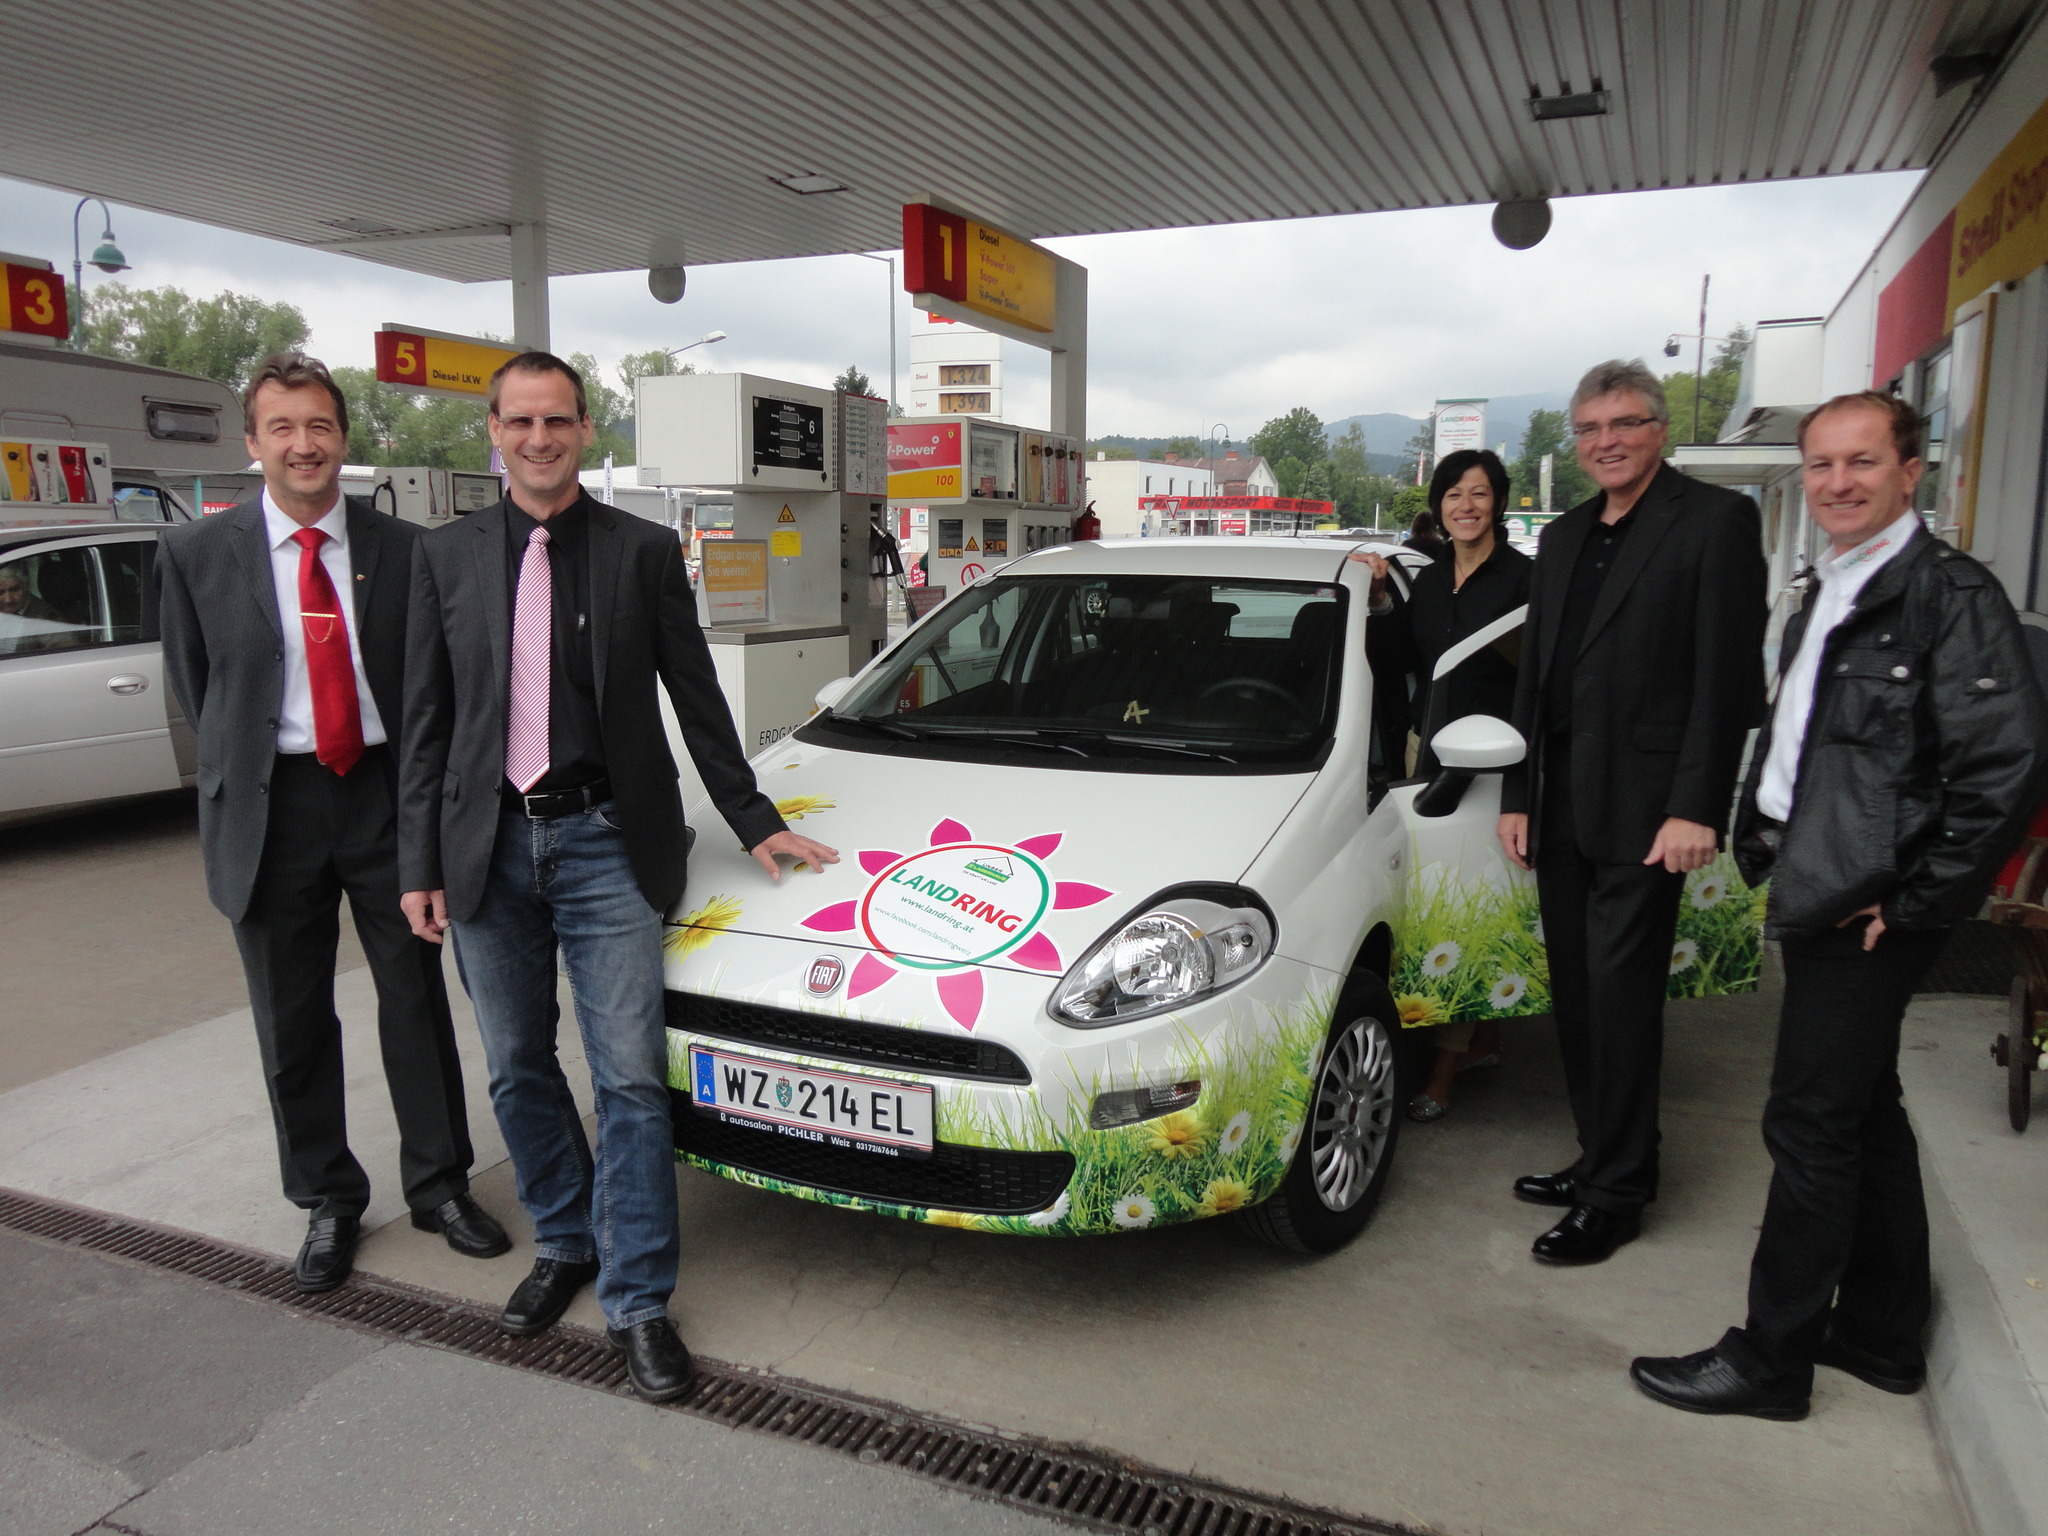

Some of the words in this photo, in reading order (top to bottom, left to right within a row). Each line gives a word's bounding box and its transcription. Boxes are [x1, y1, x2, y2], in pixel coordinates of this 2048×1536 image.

[979, 228, 1000, 247] Diesel
[1957, 187, 2006, 278] Shell
[939, 224, 953, 282] 1
[979, 269, 999, 286] Super
[24, 278, 55, 325] 3
[395, 341, 417, 376] 5
[432, 369, 459, 382] Diesel
[461, 375, 481, 385] LKW
[915, 373, 929, 381] Diesel
[915, 401, 928, 410] Super
[808, 420, 816, 435] 6
[936, 475, 954, 486] 100
[1186, 496, 1260, 509] MOTORSPORT
[707, 548, 735, 563] Erdgas
[736, 549, 761, 563] bringt
[707, 564, 720, 577] Sie
[759, 724, 803, 746] ERDGA
[889, 868, 1023, 933] LANDRING
[900, 895, 975, 934] www.landring.at
[874, 905, 972, 957] www.facebook.com/landringweiz
[811, 965, 838, 986] FIAT
[702, 1084, 711, 1097] A
[723, 1063, 770, 1110] WZ
[797, 1079, 859, 1127] 214
[871, 1090, 915, 1136] EL
[729, 1116, 773, 1133] autosalon
[778, 1125, 825, 1143] PICHLER
[831, 1136, 850, 1148] Weiz
[855, 1142, 899, 1157] 03172/67666
